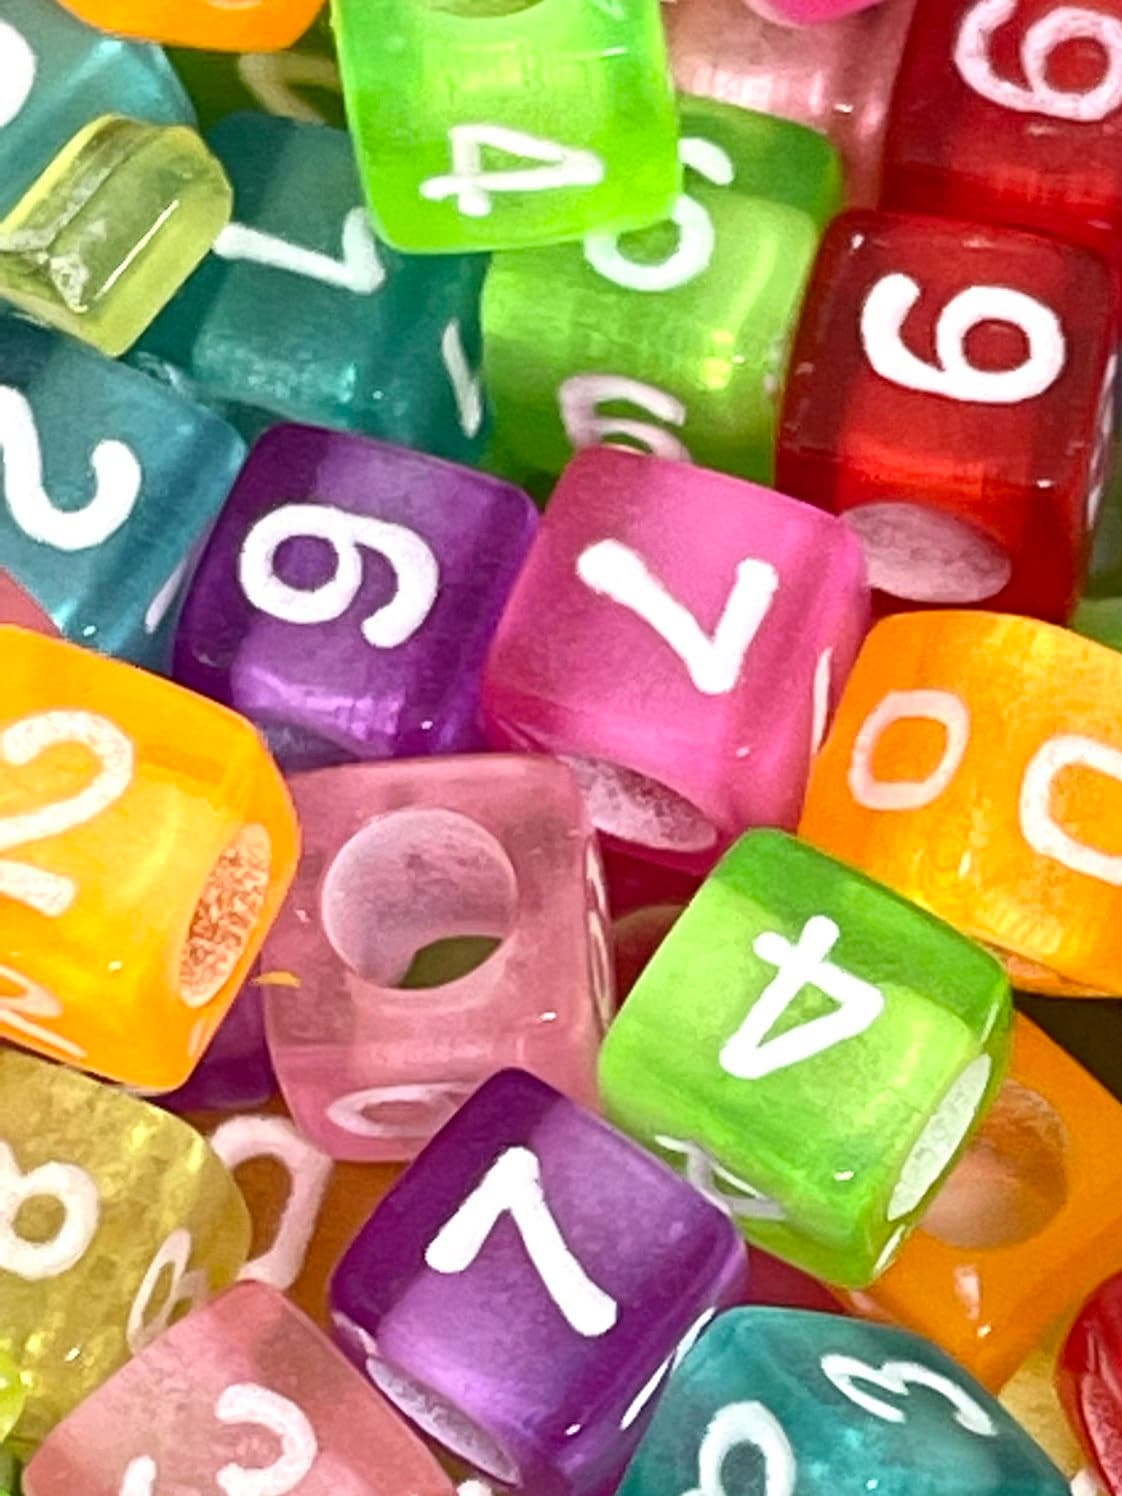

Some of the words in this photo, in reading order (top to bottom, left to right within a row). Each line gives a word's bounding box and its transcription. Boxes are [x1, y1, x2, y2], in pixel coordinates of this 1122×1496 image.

[419, 123, 605, 216] 4
[577, 538, 779, 694] 7
[0, 709, 134, 917] 2
[848, 689, 971, 810] 0
[719, 915, 885, 1080] 4
[424, 1146, 617, 1337] 7
[819, 1353, 1000, 1437] 3
